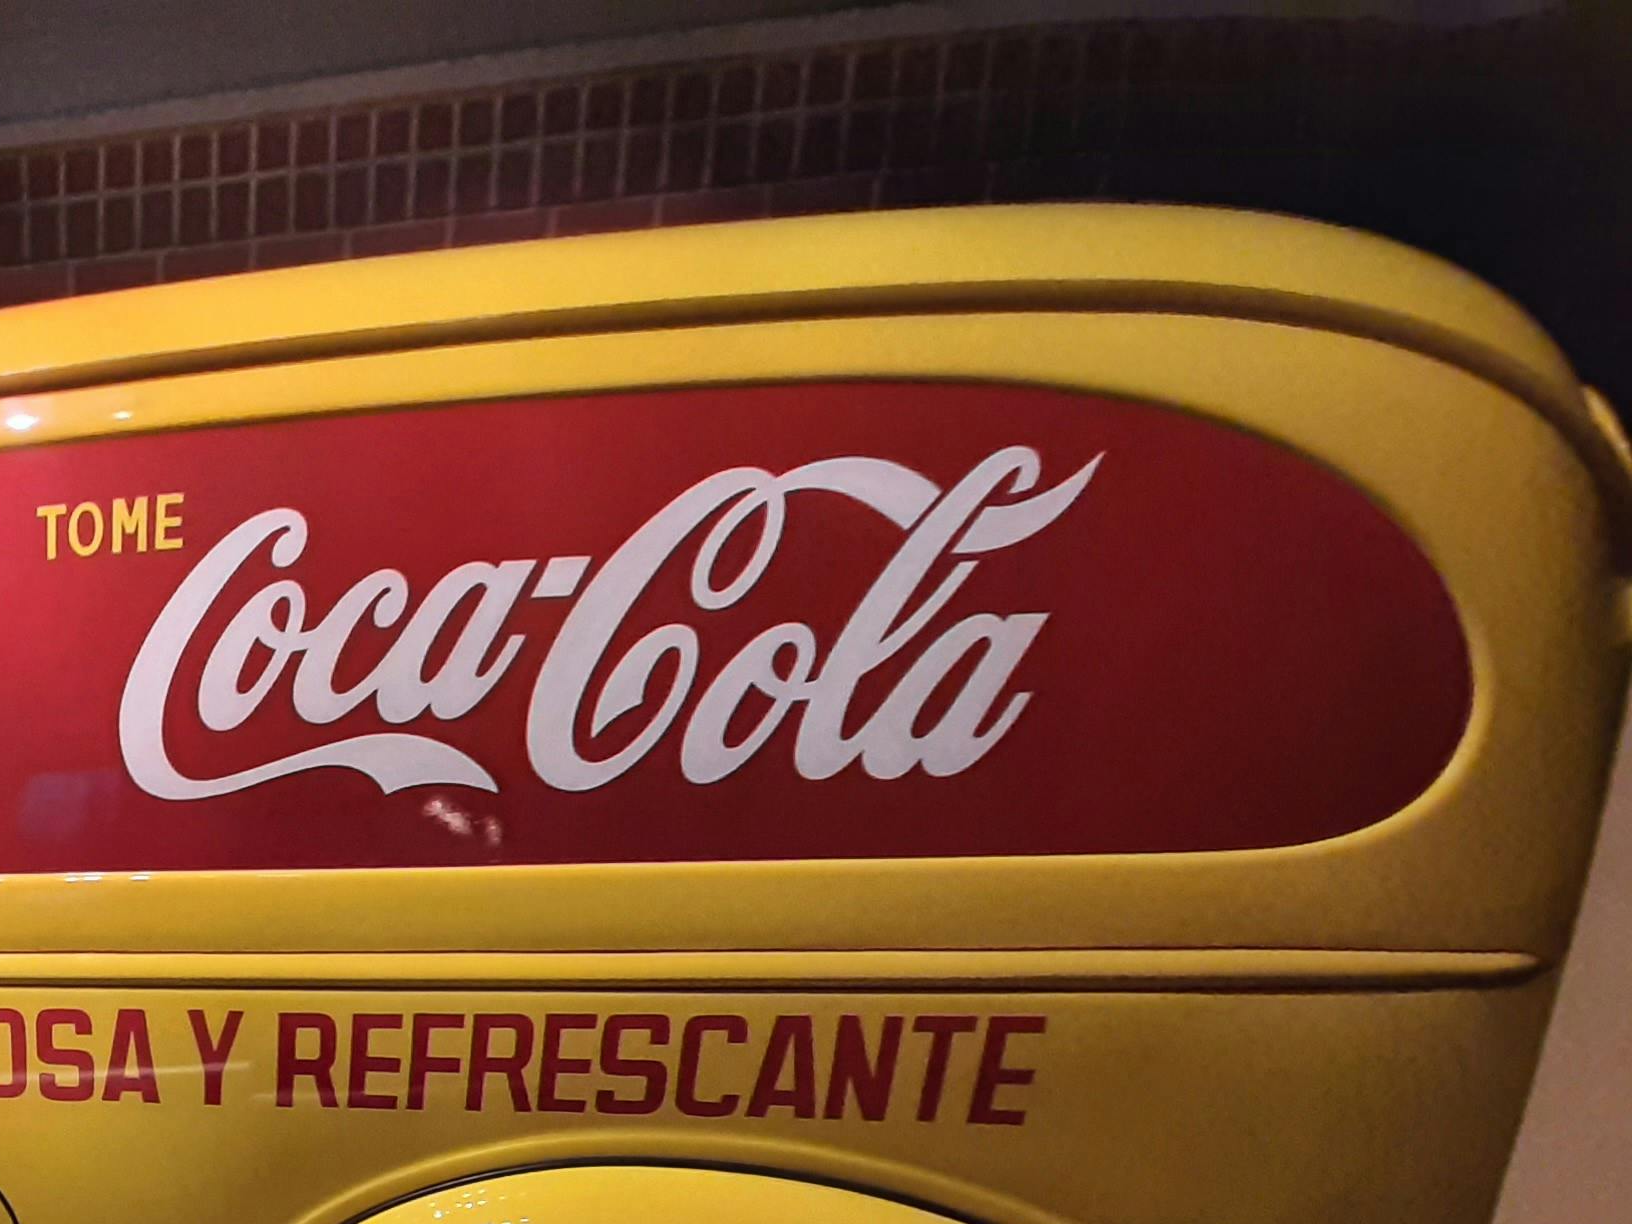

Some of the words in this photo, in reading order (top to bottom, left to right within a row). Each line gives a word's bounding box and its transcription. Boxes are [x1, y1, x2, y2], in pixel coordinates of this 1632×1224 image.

[35, 491, 186, 562] TOME
[119, 445, 1106, 800] Coca-Cola
[187, 1009, 242, 1108] Y
[274, 1009, 1048, 1127] REFRESCANTE
